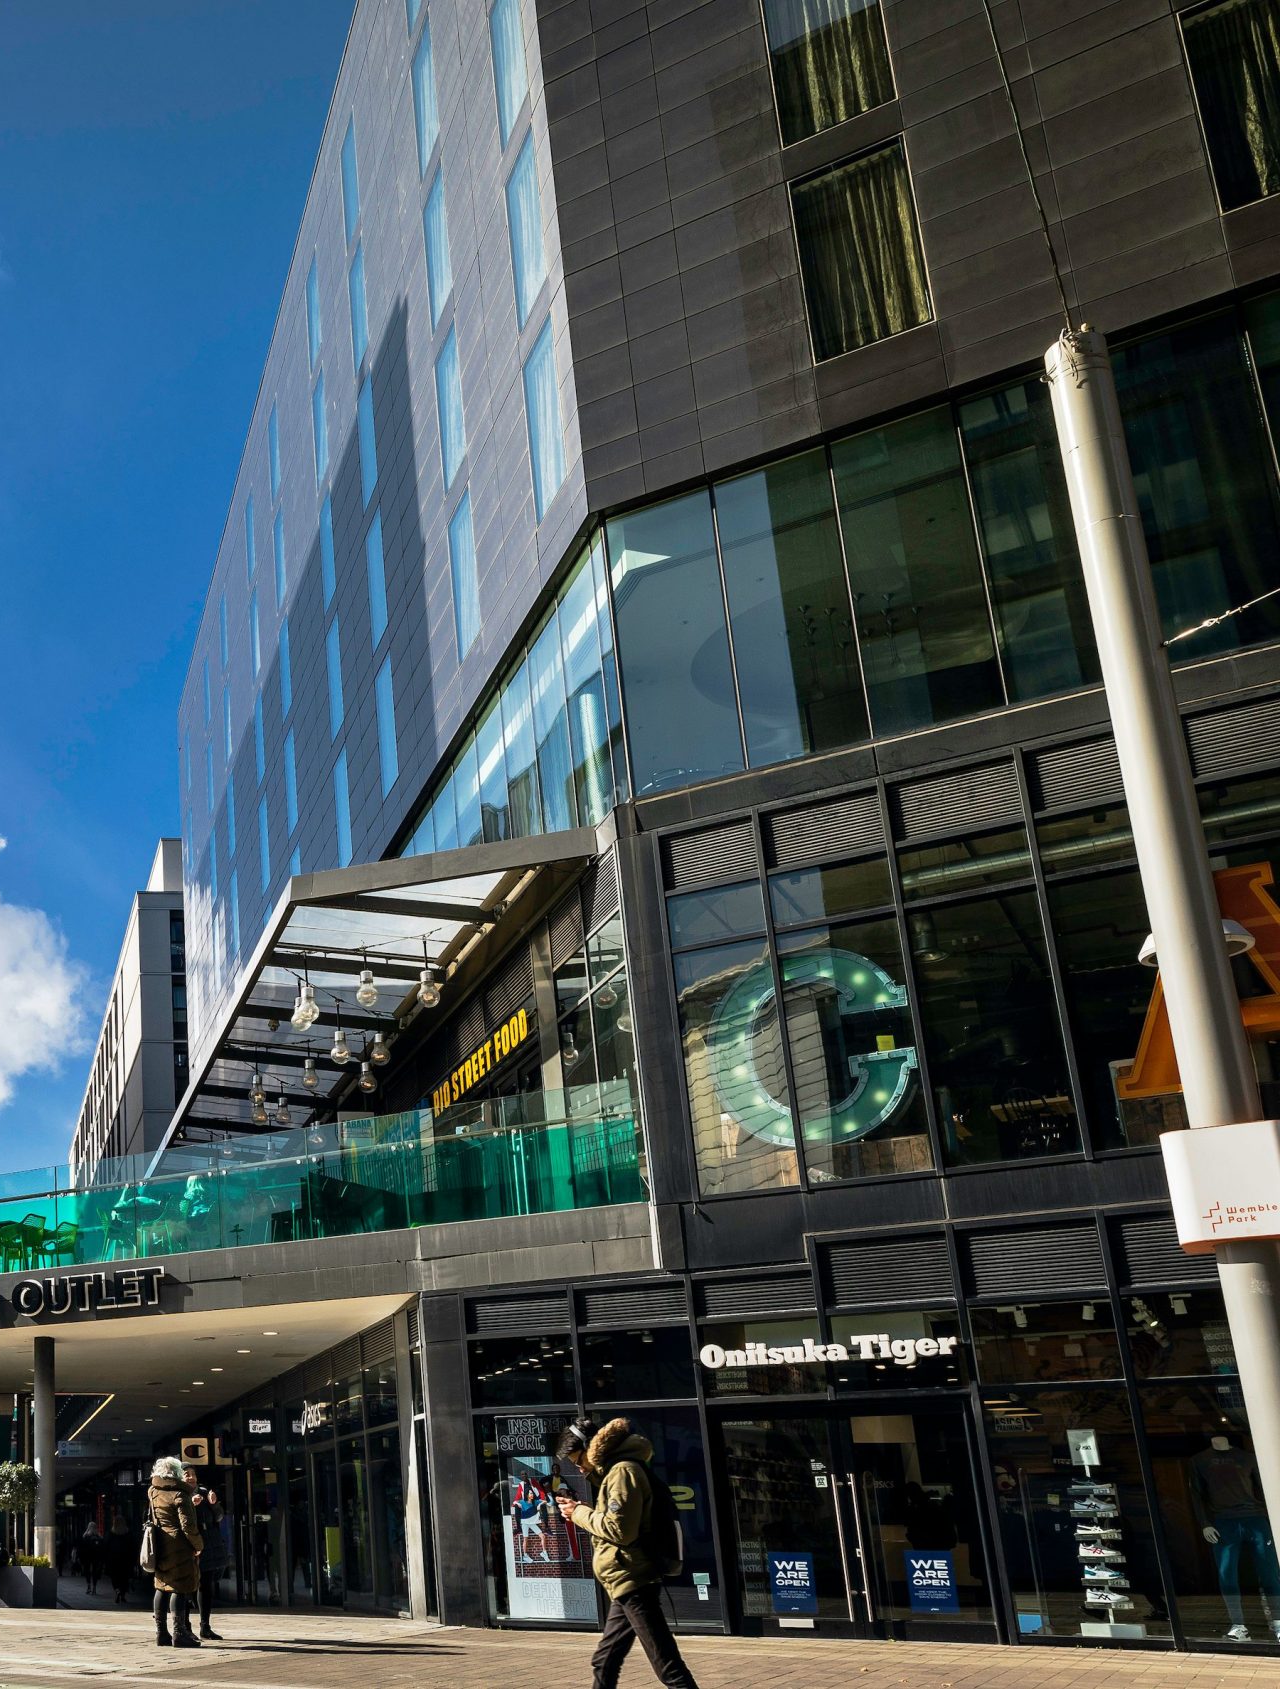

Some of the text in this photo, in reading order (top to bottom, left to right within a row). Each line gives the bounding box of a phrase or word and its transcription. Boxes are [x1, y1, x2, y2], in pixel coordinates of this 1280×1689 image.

[433, 1008, 528, 1118] RIO STREET FOOD
[1226, 1204, 1278, 1214] Wemble
[1228, 1215, 1257, 1223] Park
[11, 1266, 165, 1317] OUTLET
[699, 1333, 958, 1369] Onitsuka Tiger
[508, 1418, 567, 1434] INSPIRED
[500, 1435, 546, 1452] SPORT,
[774, 1561, 809, 1570] WE
[910, 1559, 948, 1569] WE
[775, 1571, 809, 1579] ARE
[912, 1570, 950, 1578] ARE
[522, 1581, 576, 1599] DEFINED
[536, 1598, 597, 1617] LIFESTYL
